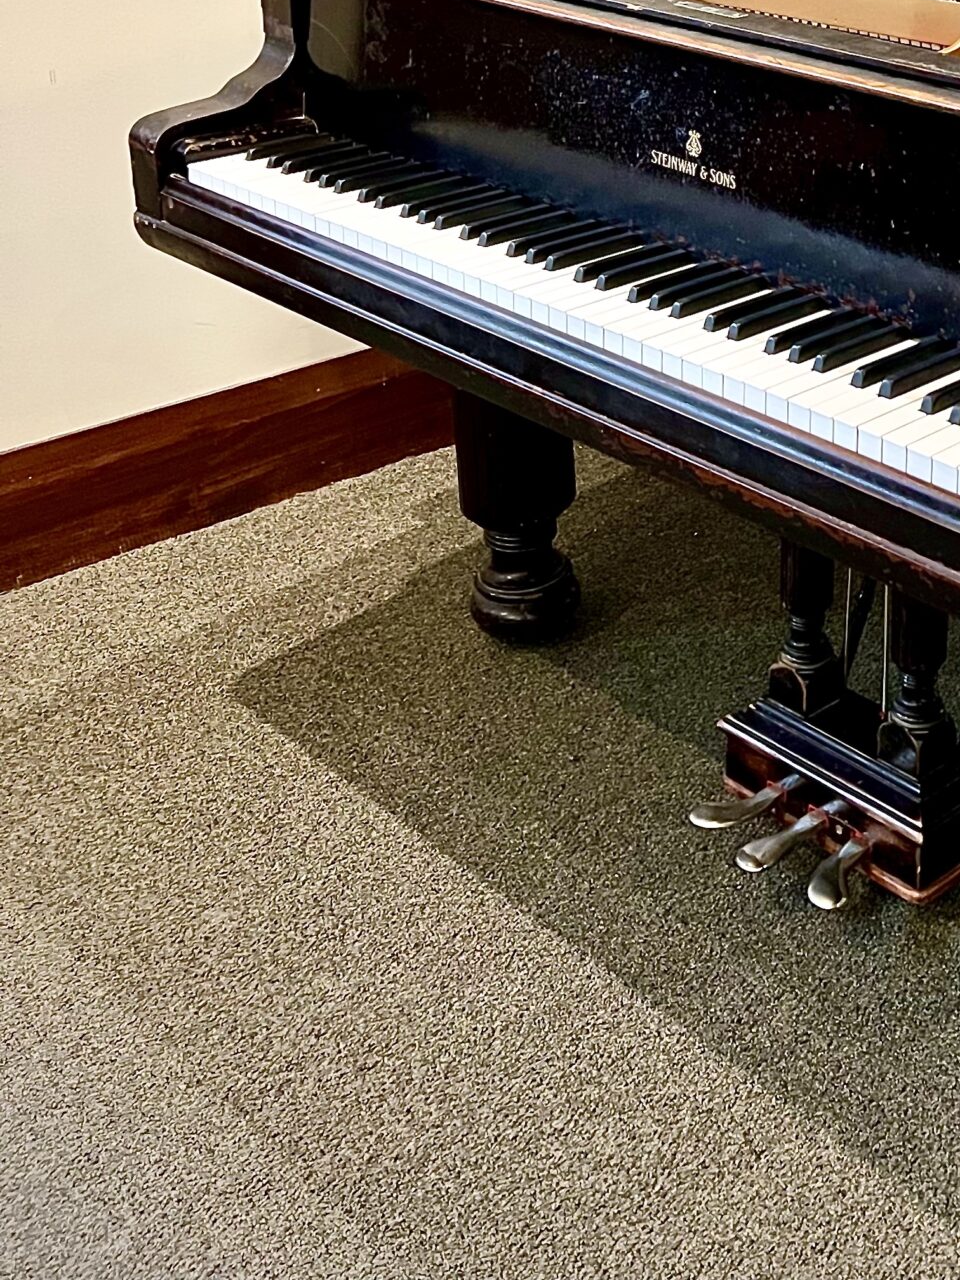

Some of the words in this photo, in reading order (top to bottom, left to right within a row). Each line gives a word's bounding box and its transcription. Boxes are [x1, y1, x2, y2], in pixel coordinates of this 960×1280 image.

[651, 149, 698, 177] STEINWAY
[700, 165, 708, 180] &
[709, 168, 736, 190] SONS
